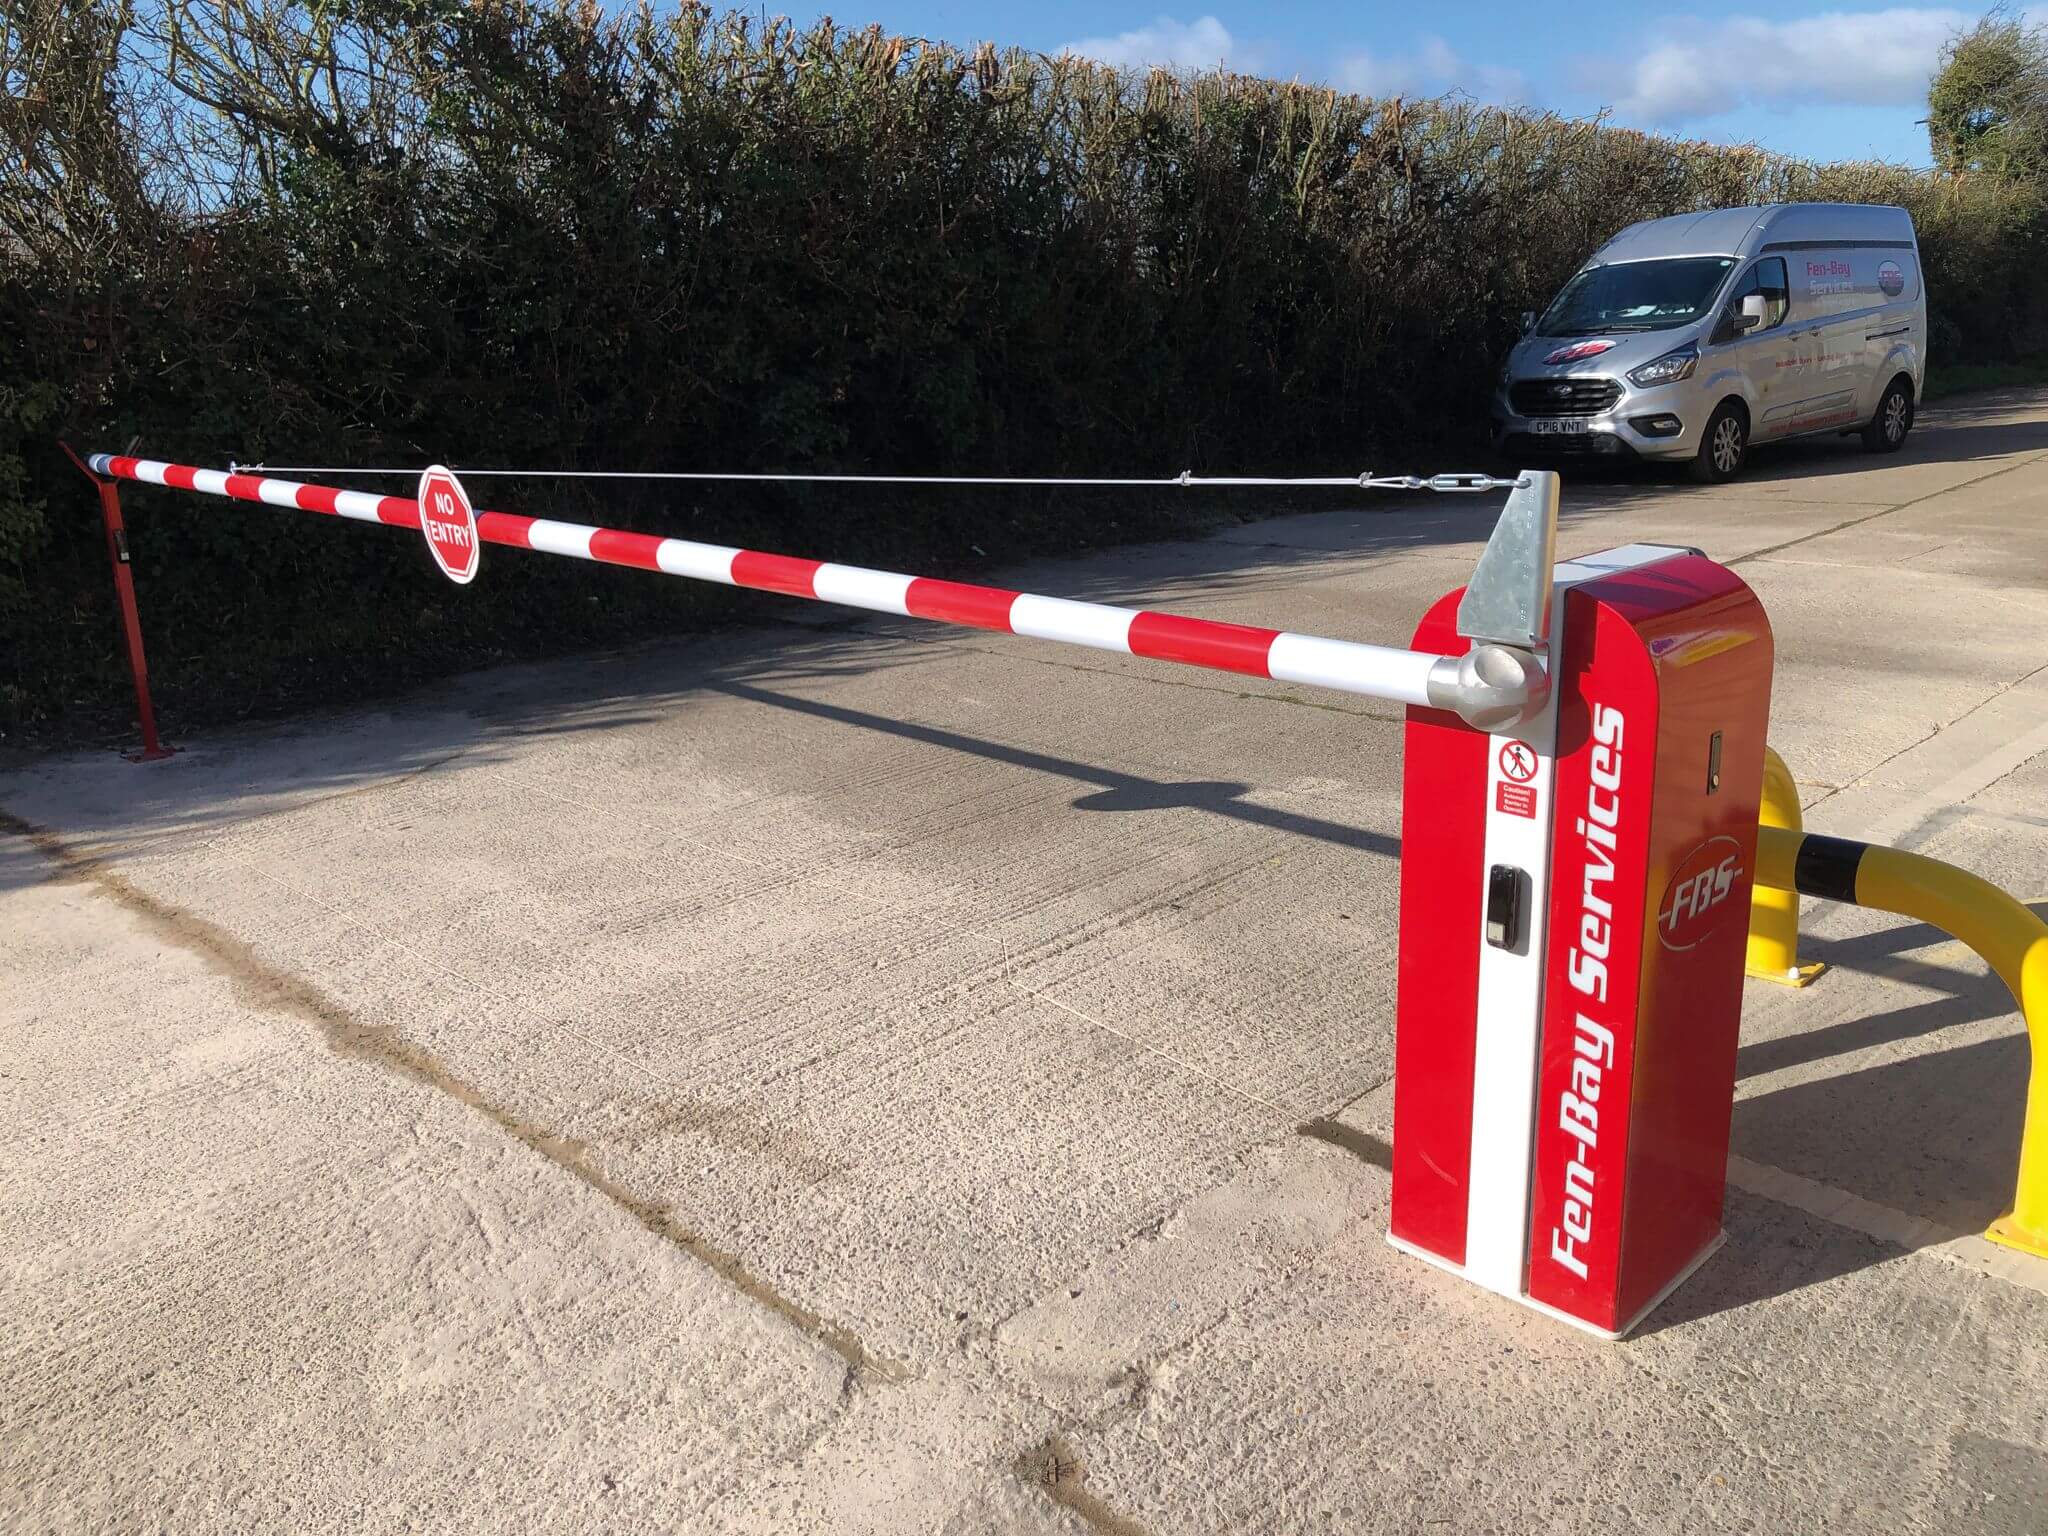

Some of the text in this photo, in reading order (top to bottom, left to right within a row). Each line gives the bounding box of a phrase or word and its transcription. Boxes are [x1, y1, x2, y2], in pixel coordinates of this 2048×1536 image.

[1807, 260, 1850, 277] Fen-Bay
[434, 492, 454, 515] NO
[429, 519, 470, 548] ENTRY
[1669, 855, 1736, 930] FBS
[1551, 703, 1624, 1281] Fen-Bay Services
